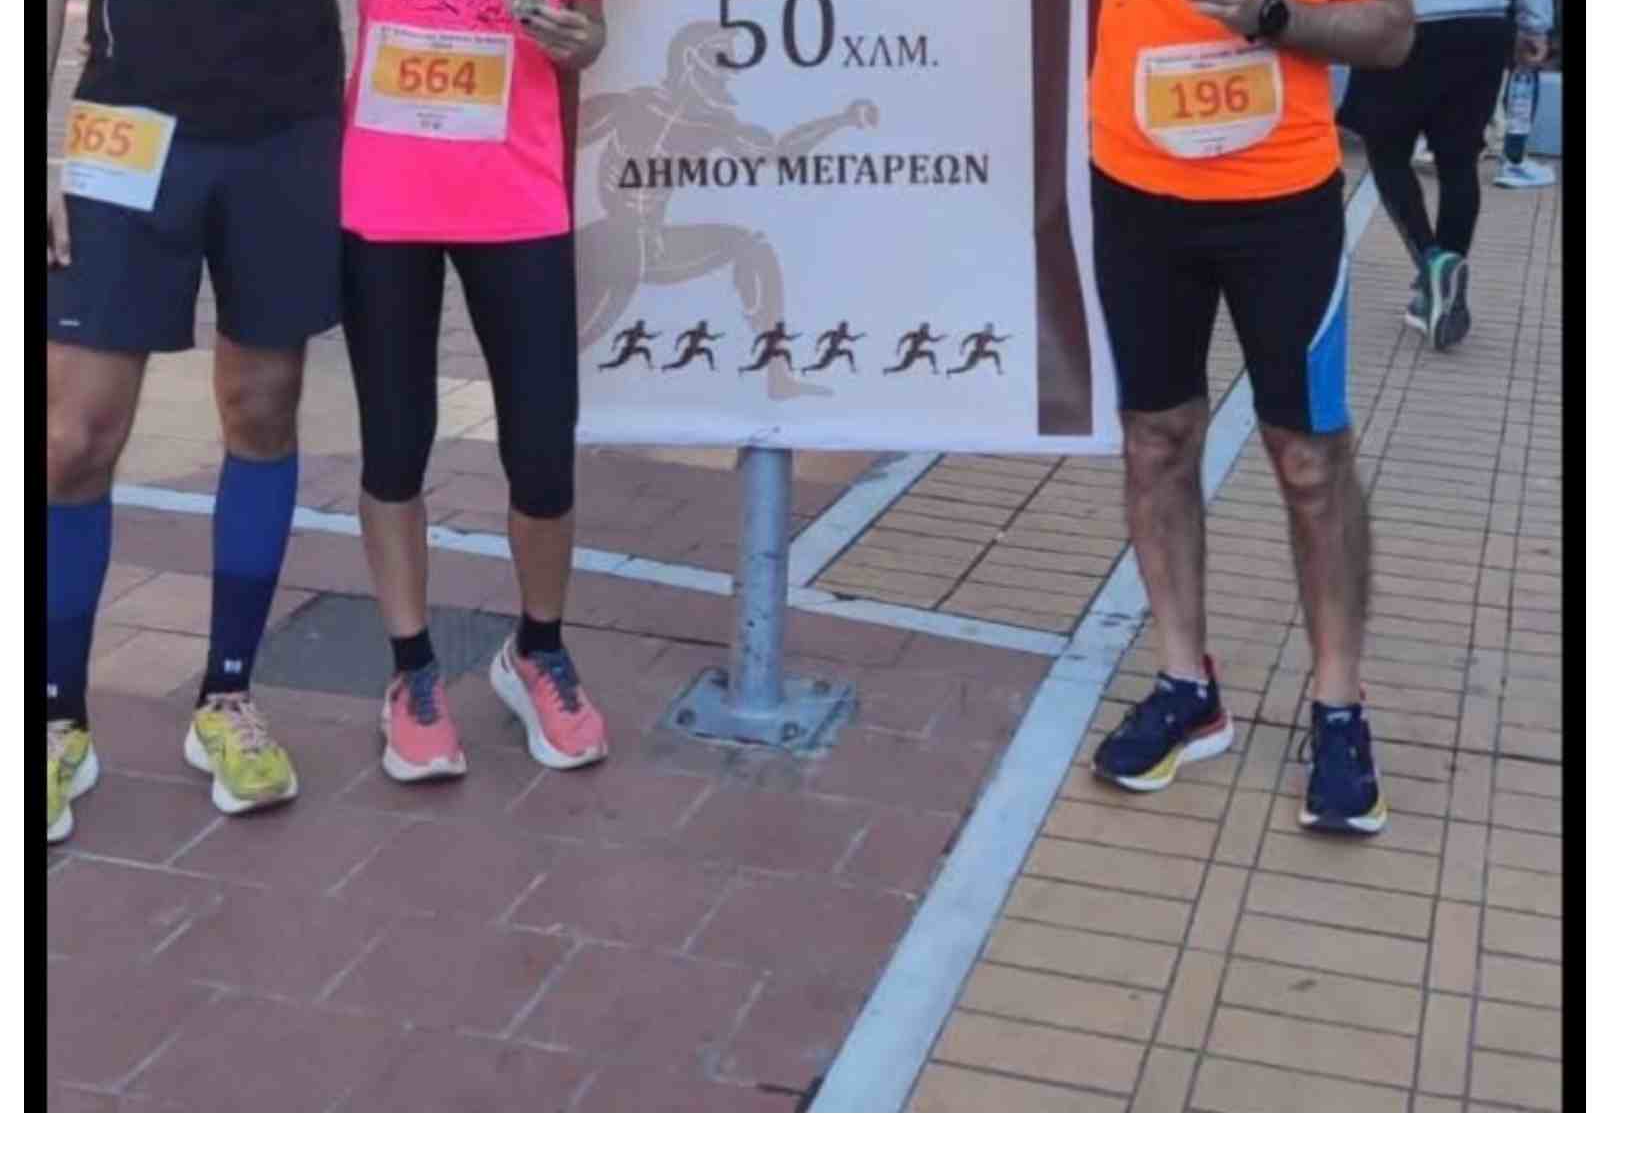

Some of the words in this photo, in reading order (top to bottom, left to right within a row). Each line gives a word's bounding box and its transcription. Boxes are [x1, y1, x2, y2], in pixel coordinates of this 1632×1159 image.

[841, 34, 939, 69] ΧΛΜ.
[1168, 74, 1250, 119] 196
[616, 156, 766, 190] ΔΗΜΟΥ
[776, 153, 990, 187] ΜΕΓΑΡΕΩΝ
